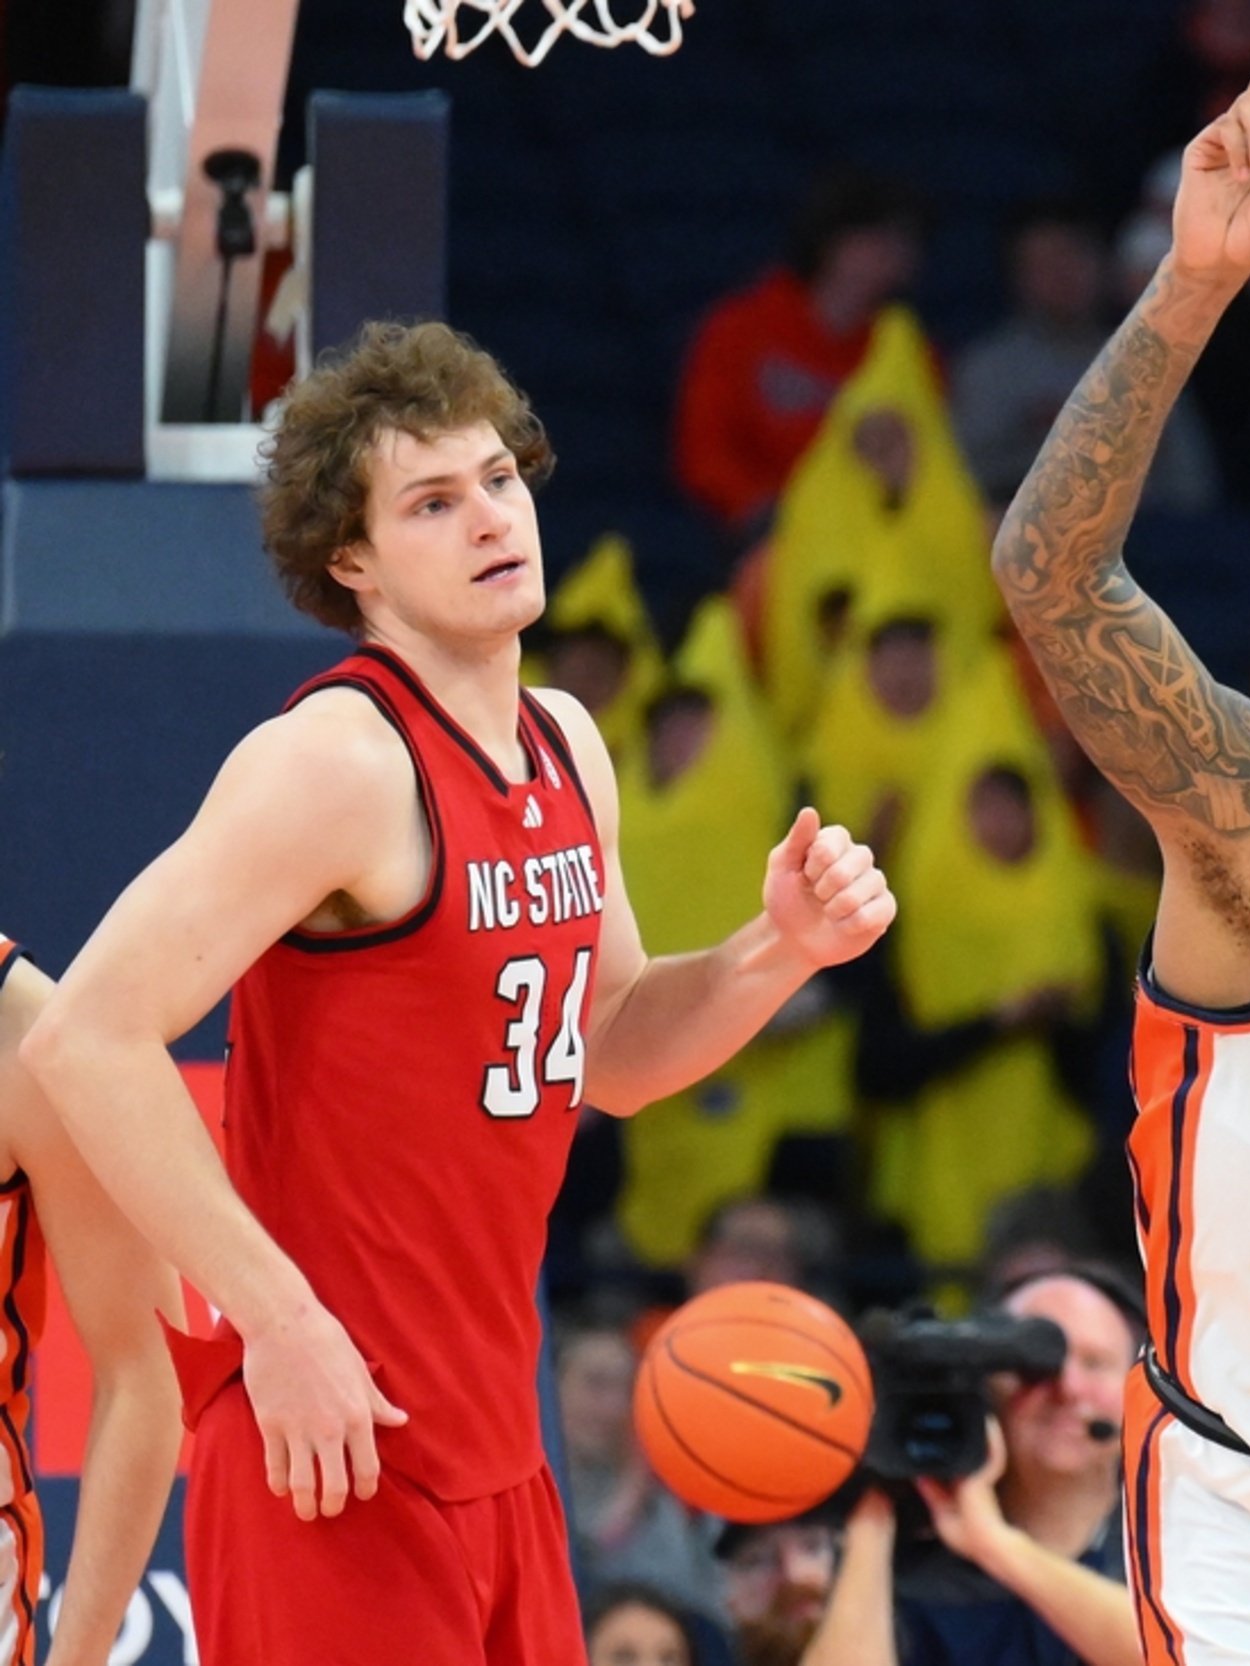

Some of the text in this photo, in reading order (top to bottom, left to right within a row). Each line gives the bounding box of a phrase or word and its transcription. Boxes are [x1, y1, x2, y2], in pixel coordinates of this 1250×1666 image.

[466, 843, 604, 931] NC STATE
[479, 945, 593, 1119] 34
